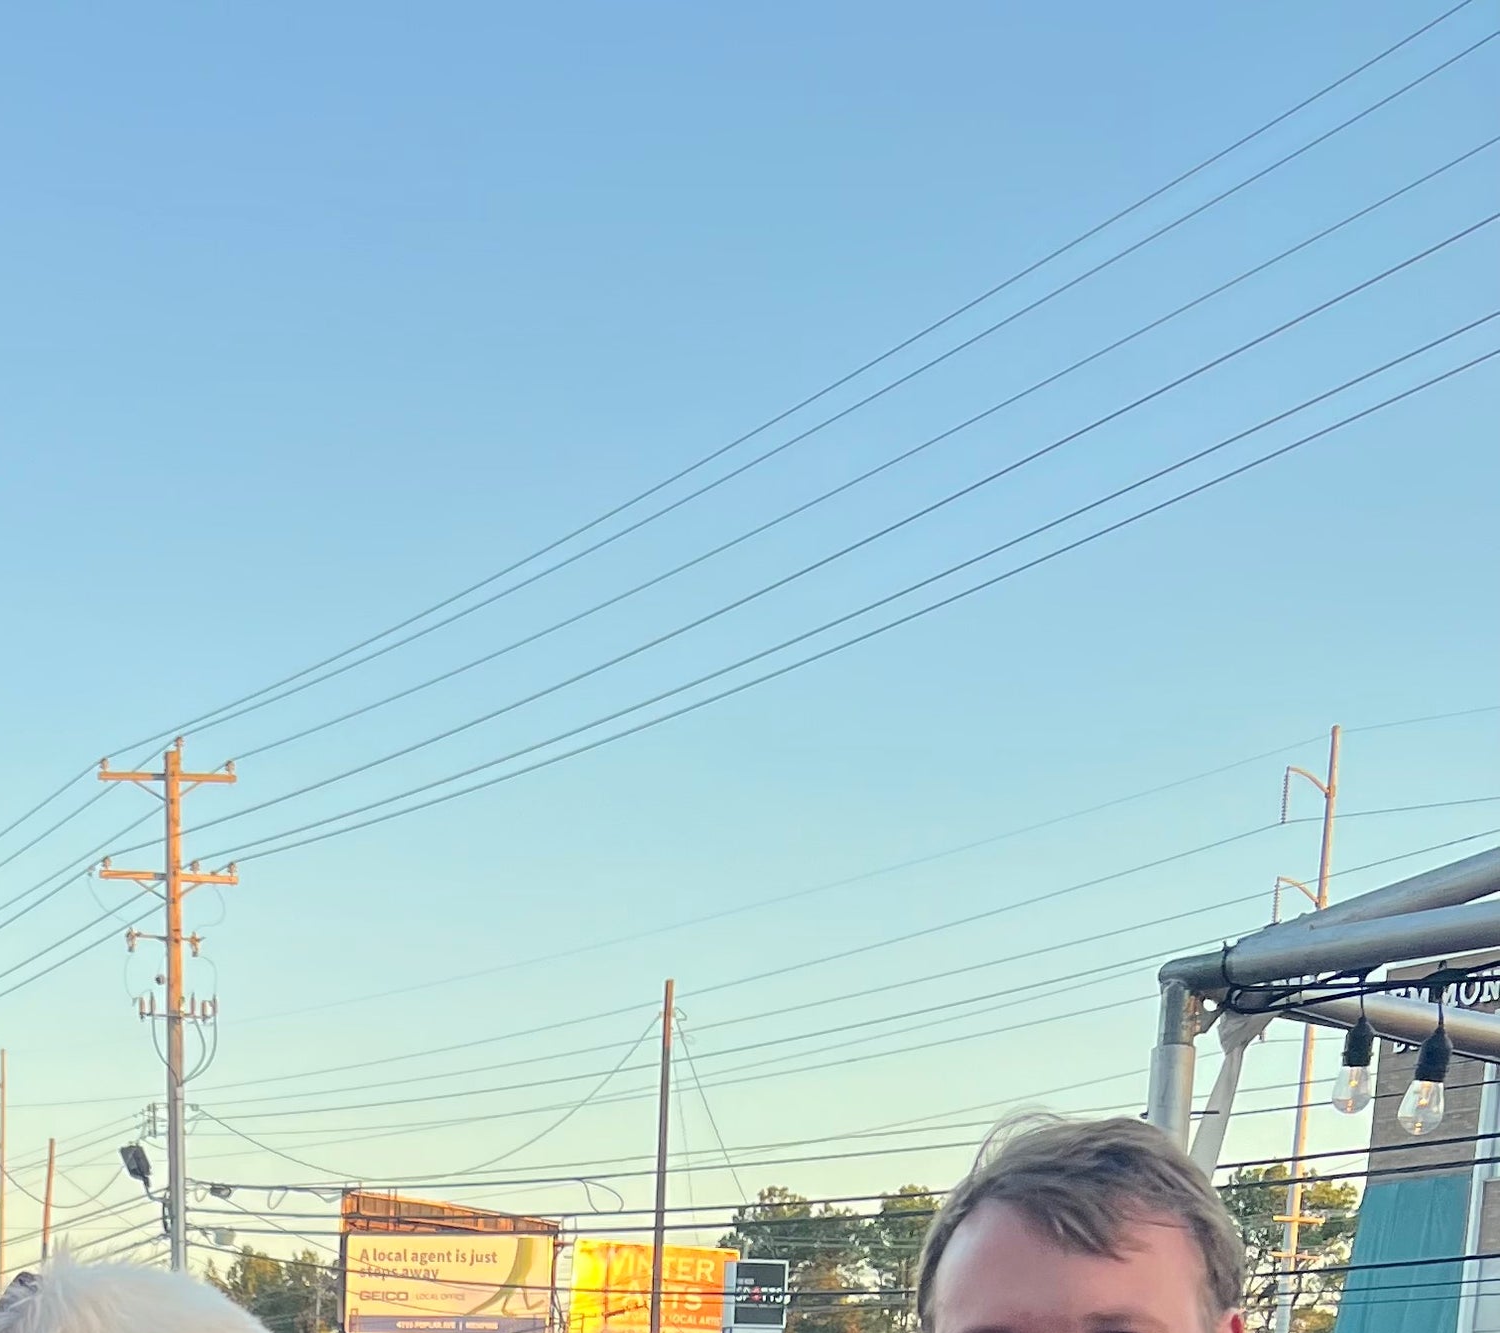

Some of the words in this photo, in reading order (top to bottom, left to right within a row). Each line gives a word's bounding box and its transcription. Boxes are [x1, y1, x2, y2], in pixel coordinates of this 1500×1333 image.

[360, 1248, 369, 1261] A
[373, 1248, 407, 1262] local
[411, 1249, 452, 1265] agent
[455, 1249, 467, 1263] is
[469, 1249, 498, 1266] just
[360, 1266, 398, 1281] steps
[401, 1267, 439, 1280] away
[359, 1291, 409, 1302] GEICO
[622, 1280, 702, 1311] ATS
